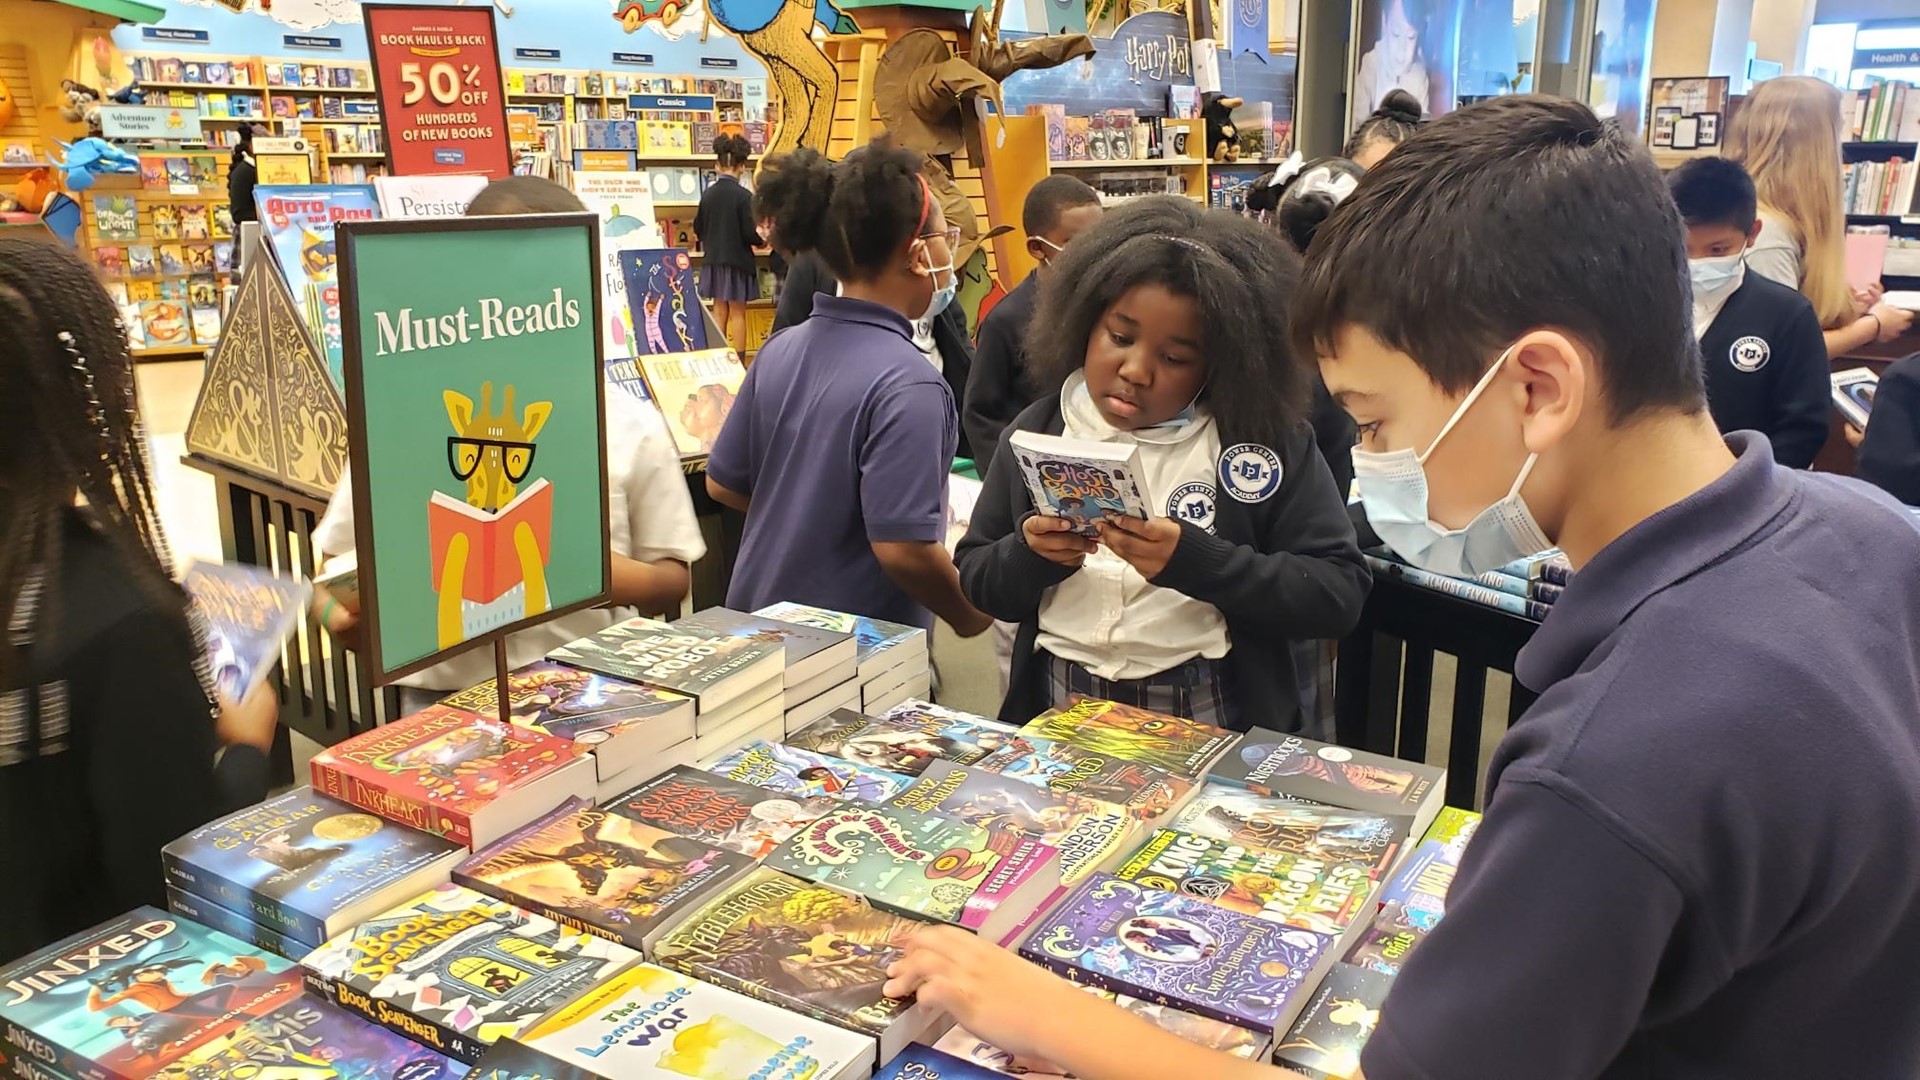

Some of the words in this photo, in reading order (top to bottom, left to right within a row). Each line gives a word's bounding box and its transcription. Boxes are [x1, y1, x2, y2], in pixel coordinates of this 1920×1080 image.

[380, 34, 414, 45] BOOK
[416, 35, 442, 46] HAUL
[444, 36, 452, 45] IS
[455, 35, 486, 46] BACK!
[1124, 36, 1166, 86] Harry
[1871, 52, 1906, 64] Health
[1909, 53, 1920, 63] &
[462, 92, 488, 105] OFF
[657, 98, 686, 107] Classics
[111, 113, 157, 122] Adventure
[119, 122, 150, 131] Stories
[416, 112, 478, 125] HUNDREDS
[402, 130, 419, 141] OF
[421, 128, 448, 140] NEW
[452, 127, 493, 139] BOOKS
[374, 287, 581, 356] Must-Reads
[653, 360, 688, 381] FREE
[688, 358, 707, 378] AT
[1224, 446, 1250, 462] POWER
[1252, 446, 1278, 470] CENTER
[1246, 466, 1256, 478] P
[1230, 487, 1260, 500] ACADEMY
[1424, 576, 1462, 594] ALMOST
[1464, 586, 1500, 606] FLYING
[626, 636, 702, 667] WILD
[643, 636, 730, 679] ROBOT
[700, 665, 732, 683] PETER
[728, 650, 762, 671] BROWN
[340, 713, 464, 765] INKHEART
[1185, 749, 1203, 766] ERIN
[1244, 736, 1304, 786] NIGHTBOOKS
[354, 778, 425, 827] INKHEART
[213, 804, 324, 850] GAIMAN
[225, 807, 289, 832] NEIL
[810, 818, 837, 842] NAME
[841, 814, 863, 822] OF
[862, 816, 890, 834] THIS
[814, 840, 844, 858] THE
[880, 832, 912, 854] BOOK
[904, 850, 926, 860] IS
[1065, 852, 1099, 882] ILLUSTRATIONS
[1118, 816, 1131, 834] LAZO
[1147, 834, 1213, 881] KING
[170, 866, 196, 883] GAIMAN
[984, 867, 1016, 894] SECRET
[1012, 841, 1036, 866] SERIES
[1251, 852, 1283, 874] THE
[654, 893, 678, 906] LISA
[673, 869, 714, 893] McMANN
[1256, 858, 1326, 923] DRAGON
[1312, 865, 1362, 912] FLIES
[173, 900, 198, 916] GAIMAN
[673, 877, 802, 960] FABLEHAVEN
[353, 908, 444, 958] BOOK
[353, 900, 507, 982] SCAVENGER
[5, 920, 177, 1007] JINXED
[1186, 920, 1271, 996] Twinchantment
[175, 1030, 201, 1048] AMY
[204, 988, 280, 1031] McCULLOCH
[336, 982, 375, 1018] BOOK
[378, 1002, 444, 1048] SCAVENGER
[576, 986, 692, 1058] Lemonade
[600, 1000, 641, 1023] The
[4, 1024, 56, 1065] JINXED
[188, 1007, 324, 1080] RTEMIS
